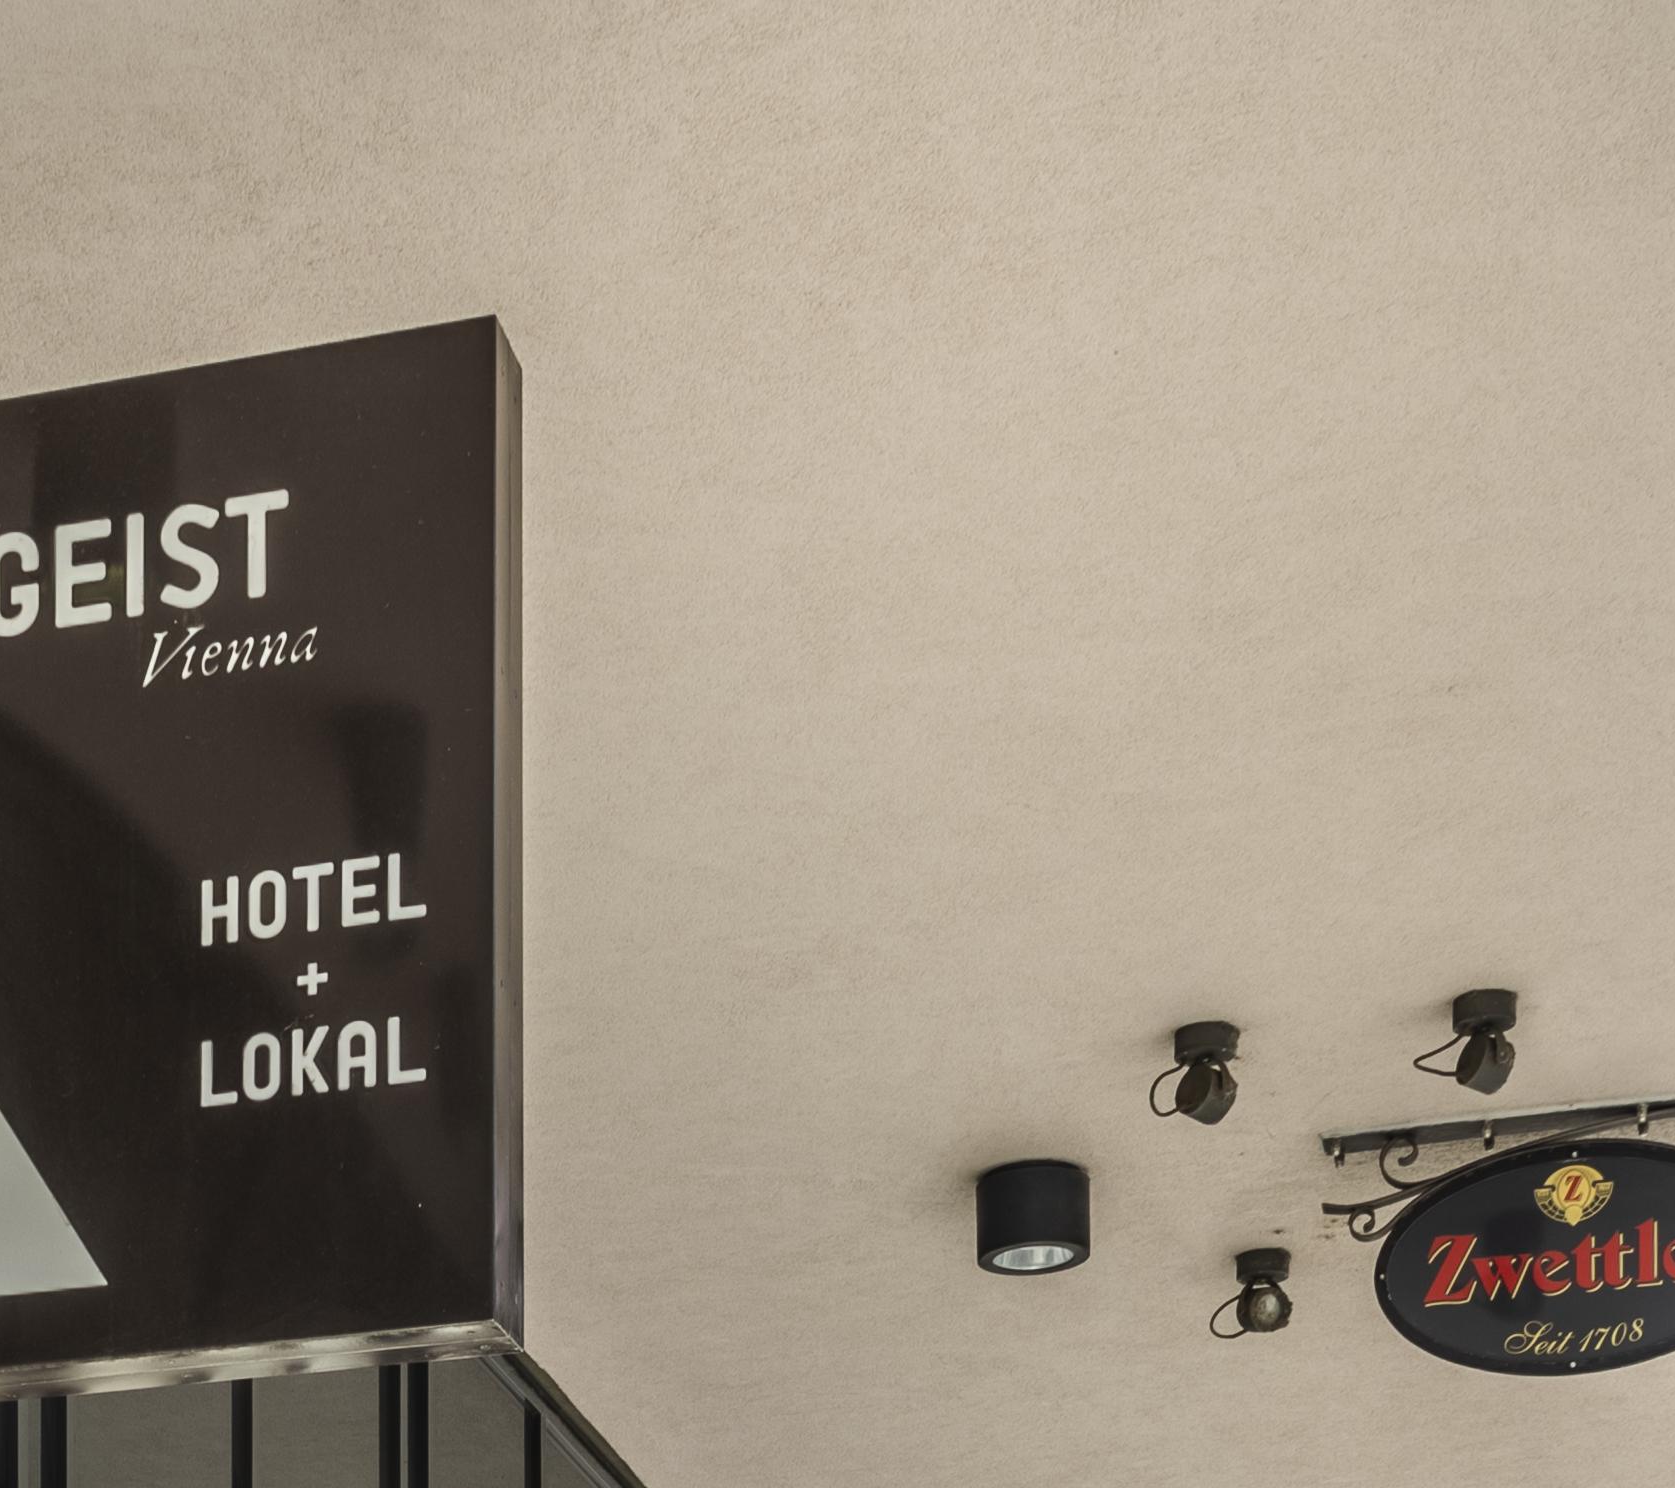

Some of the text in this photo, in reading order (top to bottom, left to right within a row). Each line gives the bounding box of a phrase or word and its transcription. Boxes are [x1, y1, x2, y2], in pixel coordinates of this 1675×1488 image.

[140, 622, 319, 690] Vienna
[200, 852, 427, 947] HOTEL
[296, 962, 329, 996] +
[200, 1016, 427, 1108] LOKAL
[1503, 1317, 1645, 1356] Seit 1708
